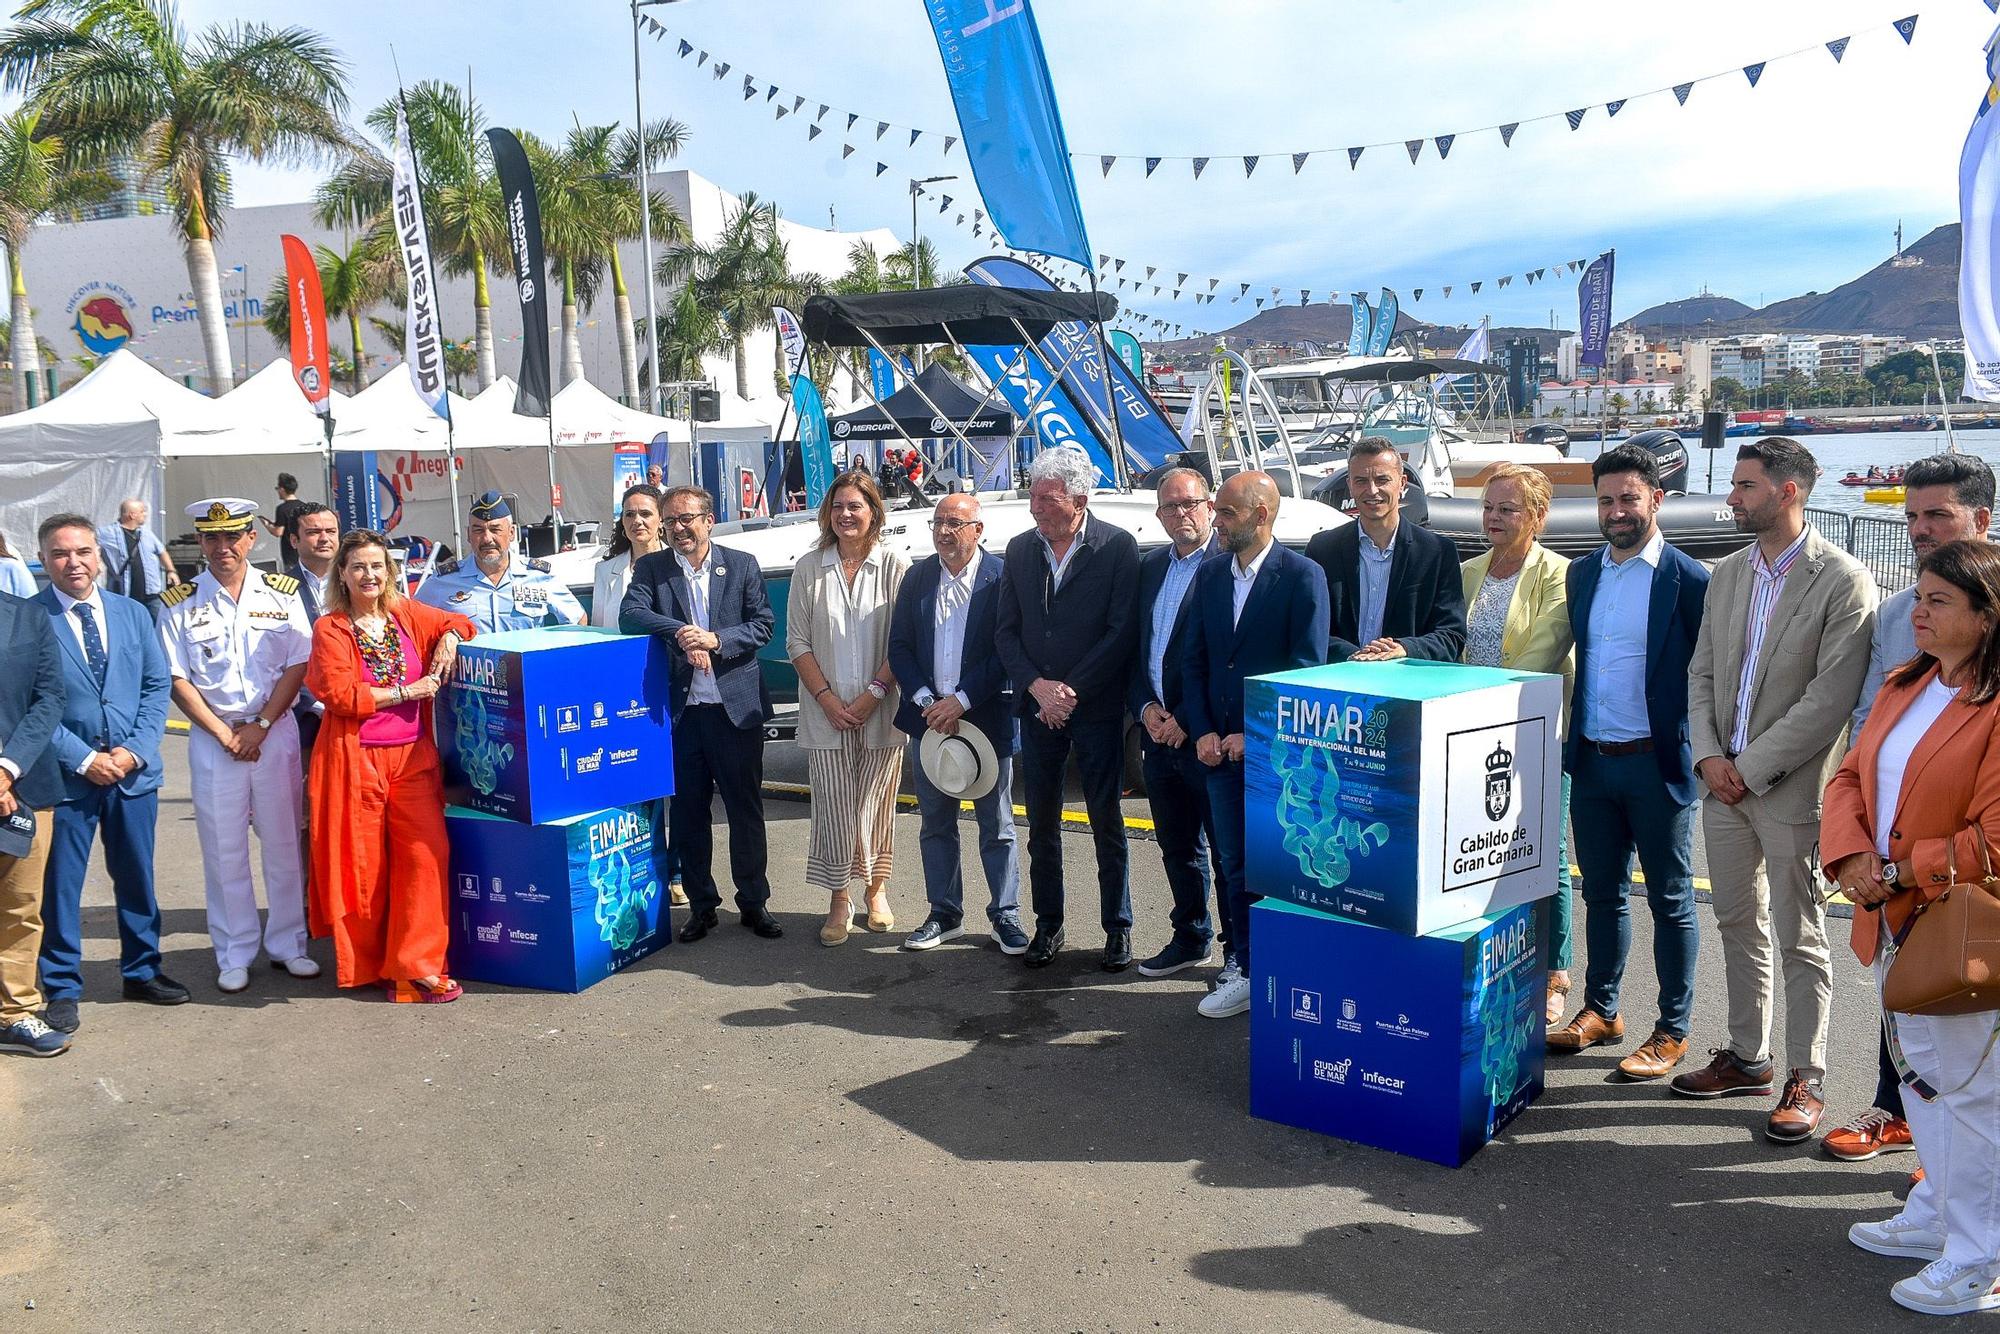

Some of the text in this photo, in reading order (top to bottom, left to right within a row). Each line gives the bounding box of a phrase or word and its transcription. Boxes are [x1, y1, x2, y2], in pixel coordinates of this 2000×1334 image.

[66, 281, 101, 314] DISCOVER
[105, 281, 137, 309] NATURE
[1592, 298, 1600, 311] DE
[1587, 313, 1599, 351] CIUDAD
[852, 423, 896, 433] MERCURY
[1657, 448, 1683, 465] RCURY
[347, 475, 357, 506] PALMAS
[458, 654, 496, 687] IMAR
[1277, 695, 1363, 745] FIMAR
[1365, 708, 1389, 729] 20
[1277, 733, 1386, 759] FERIA INTERNACIONAL DEL MAR
[1364, 727, 1387, 749] 24
[609, 748, 639, 761] infecar
[1354, 759, 1359, 767] 9
[1365, 762, 1386, 771] JUNIO
[589, 811, 639, 856] FIMAR
[1460, 824, 1527, 854] Cabildo de
[1453, 842, 1533, 875] Gran Canaria
[508, 928, 538, 941] infecar
[1482, 918, 1526, 980] FIMAR
[1375, 1020, 1394, 1029] Puertos
[1411, 1028, 1430, 1037] Palmas
[1314, 1059, 1345, 1074] CIUDAD
[1314, 1068, 1325, 1077] DE
[1327, 1070, 1345, 1081] MAR
[1360, 1068, 1405, 1089] infecar
